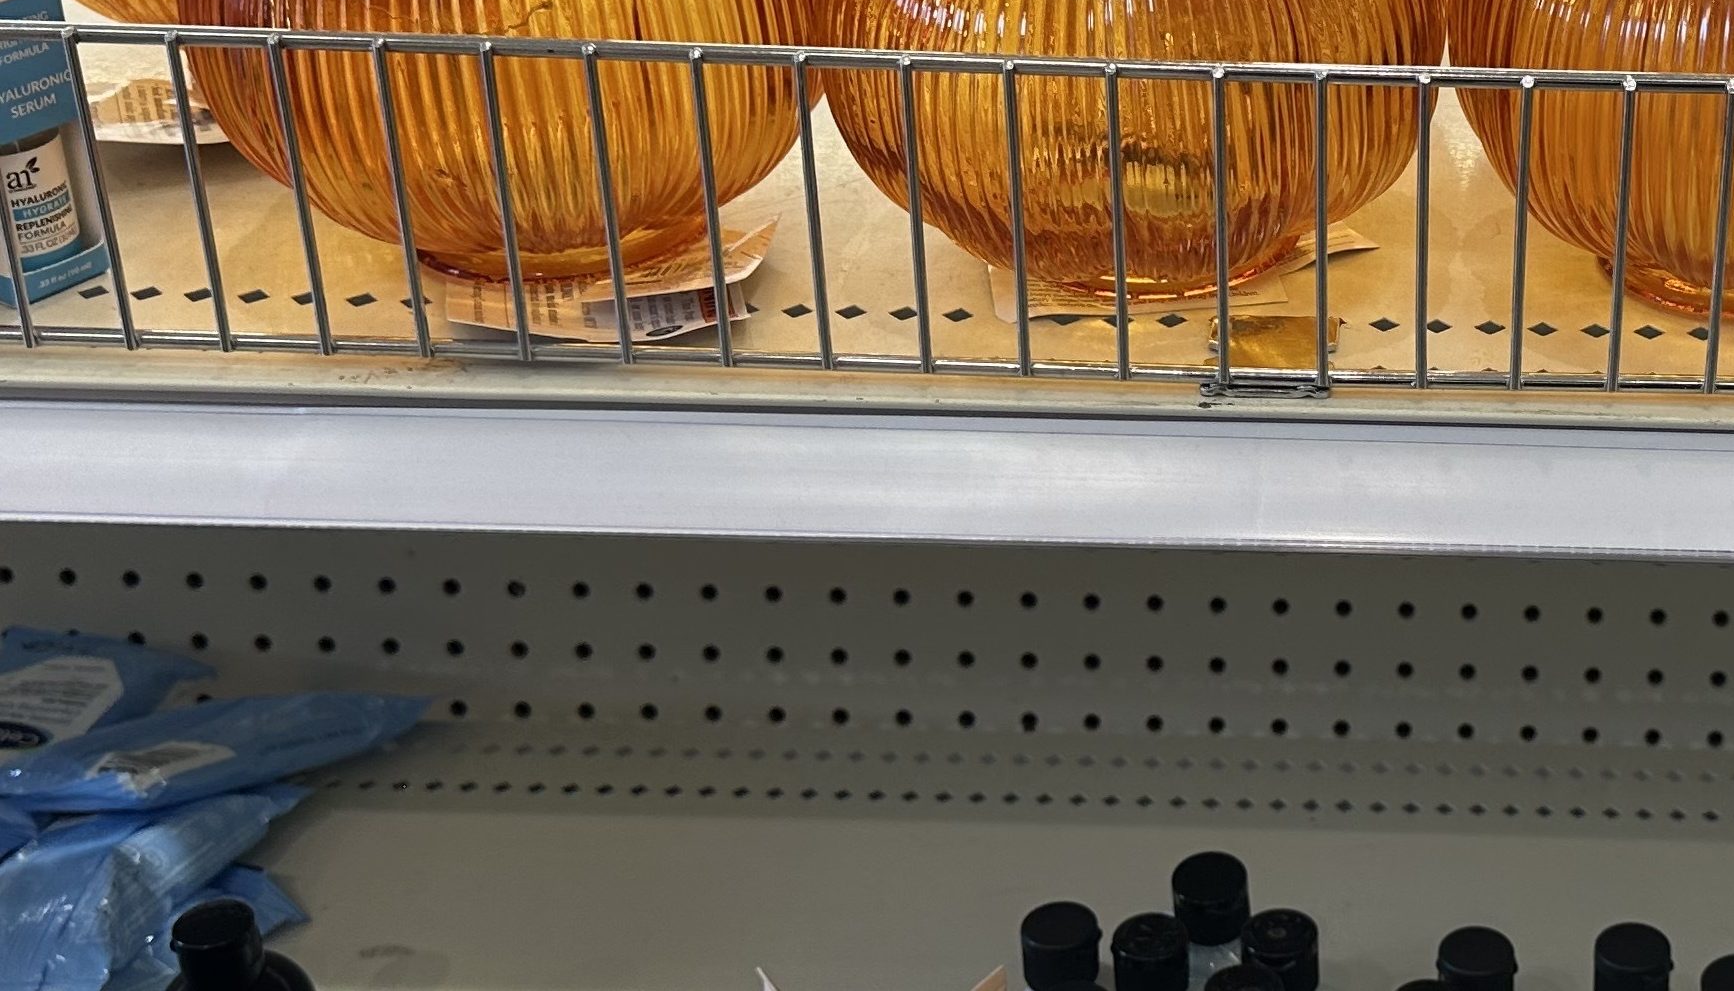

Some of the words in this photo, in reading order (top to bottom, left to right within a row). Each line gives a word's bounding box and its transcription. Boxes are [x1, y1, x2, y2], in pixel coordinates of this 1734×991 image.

[0, 69, 72, 105] YALURONIC
[10, 93, 57, 119] SERUM
[18, 221, 66, 241] FORMULA
